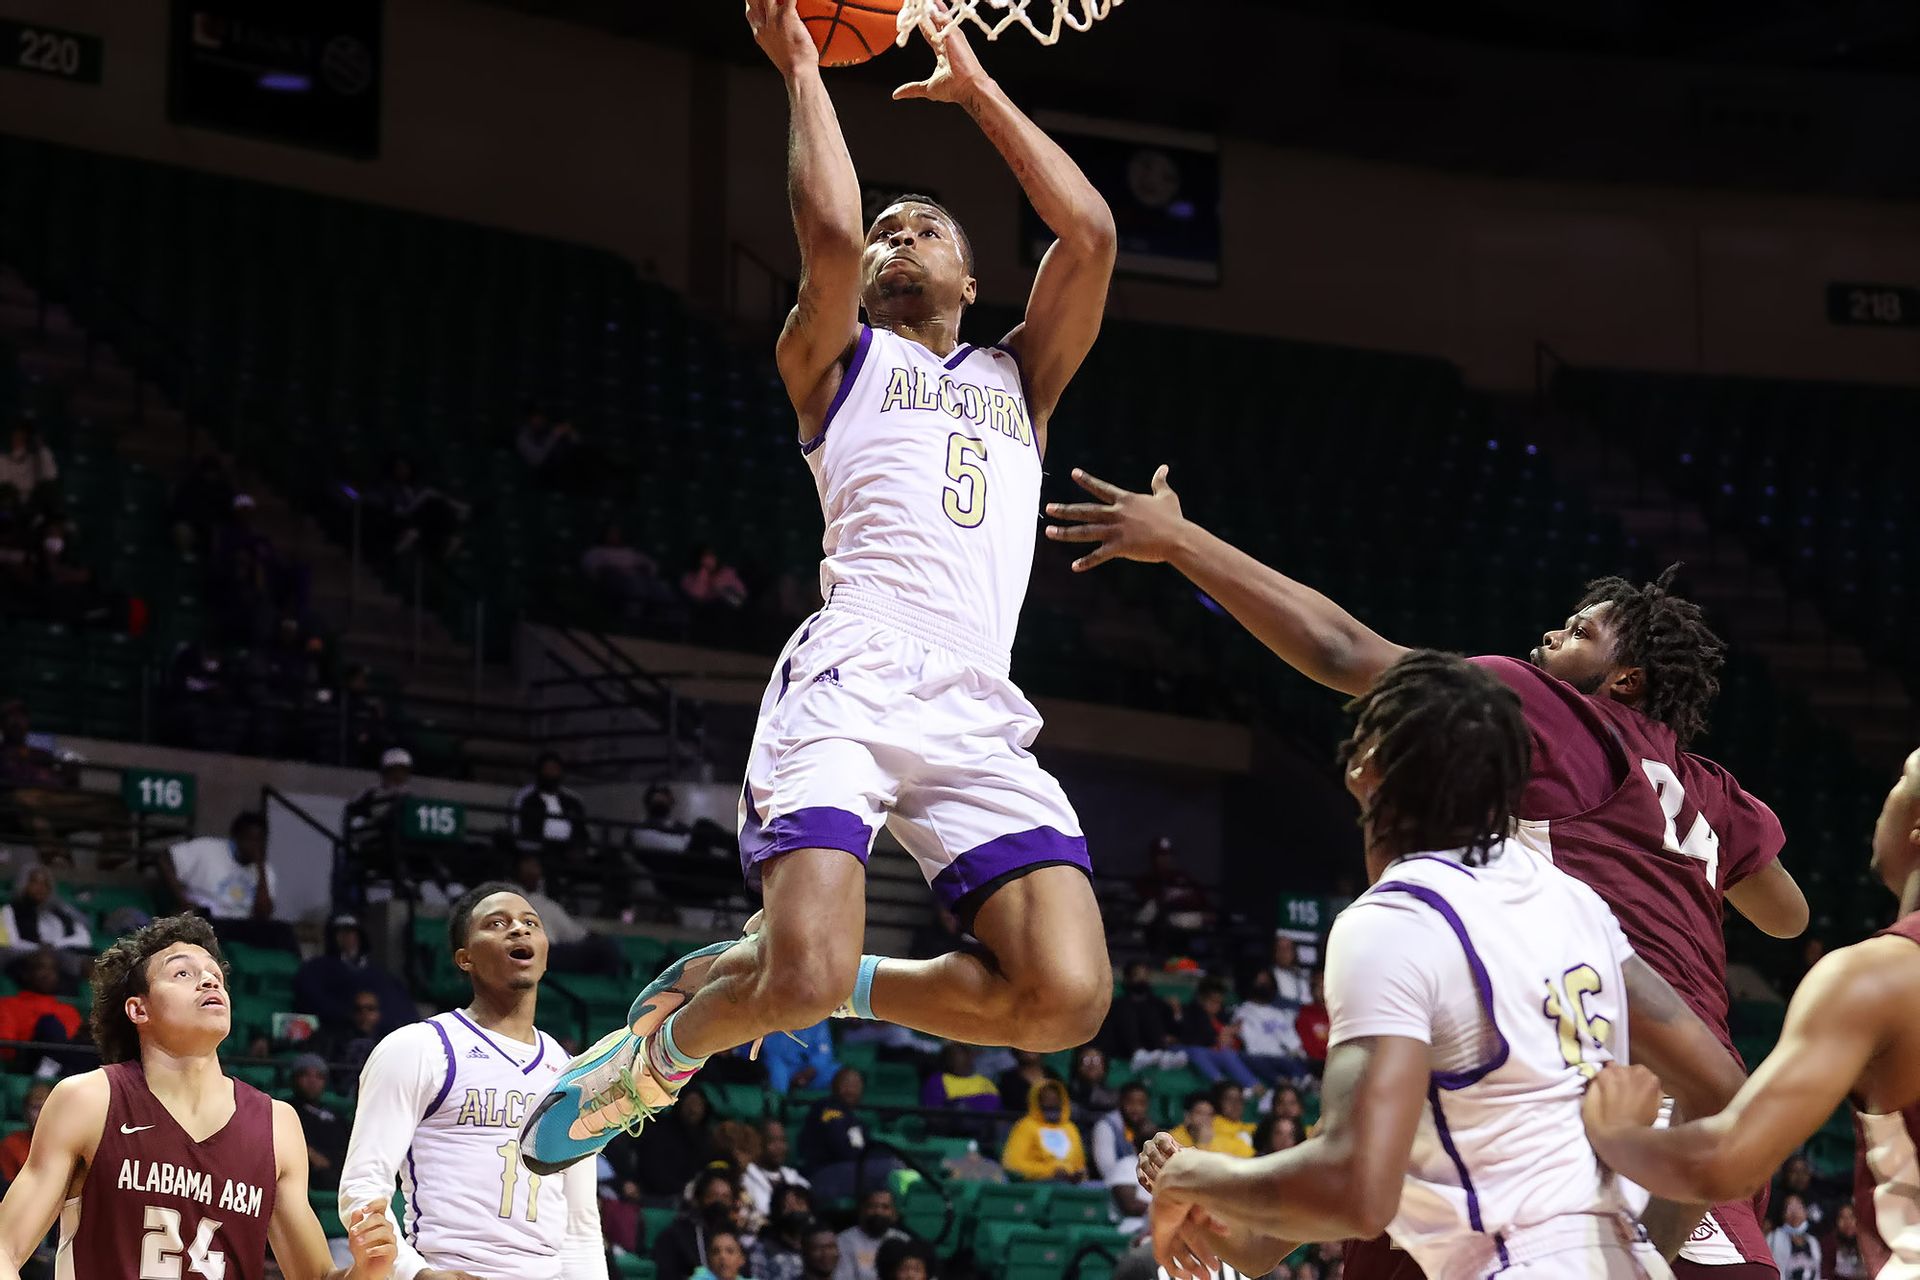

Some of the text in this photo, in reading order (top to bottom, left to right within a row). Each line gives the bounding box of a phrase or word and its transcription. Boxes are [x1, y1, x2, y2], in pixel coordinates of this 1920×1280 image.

[19, 29, 80, 76] 220
[1848, 292, 1902, 321] 218
[880, 367, 1030, 446] ALCORN
[942, 432, 988, 529] 5
[139, 777, 183, 809] 116
[416, 805, 456, 834] 115
[1286, 900, 1319, 927] 115
[117, 1159, 263, 1218] ALABAMA A&M
[496, 1139, 542, 1223] 11
[140, 1206, 227, 1280] 24
